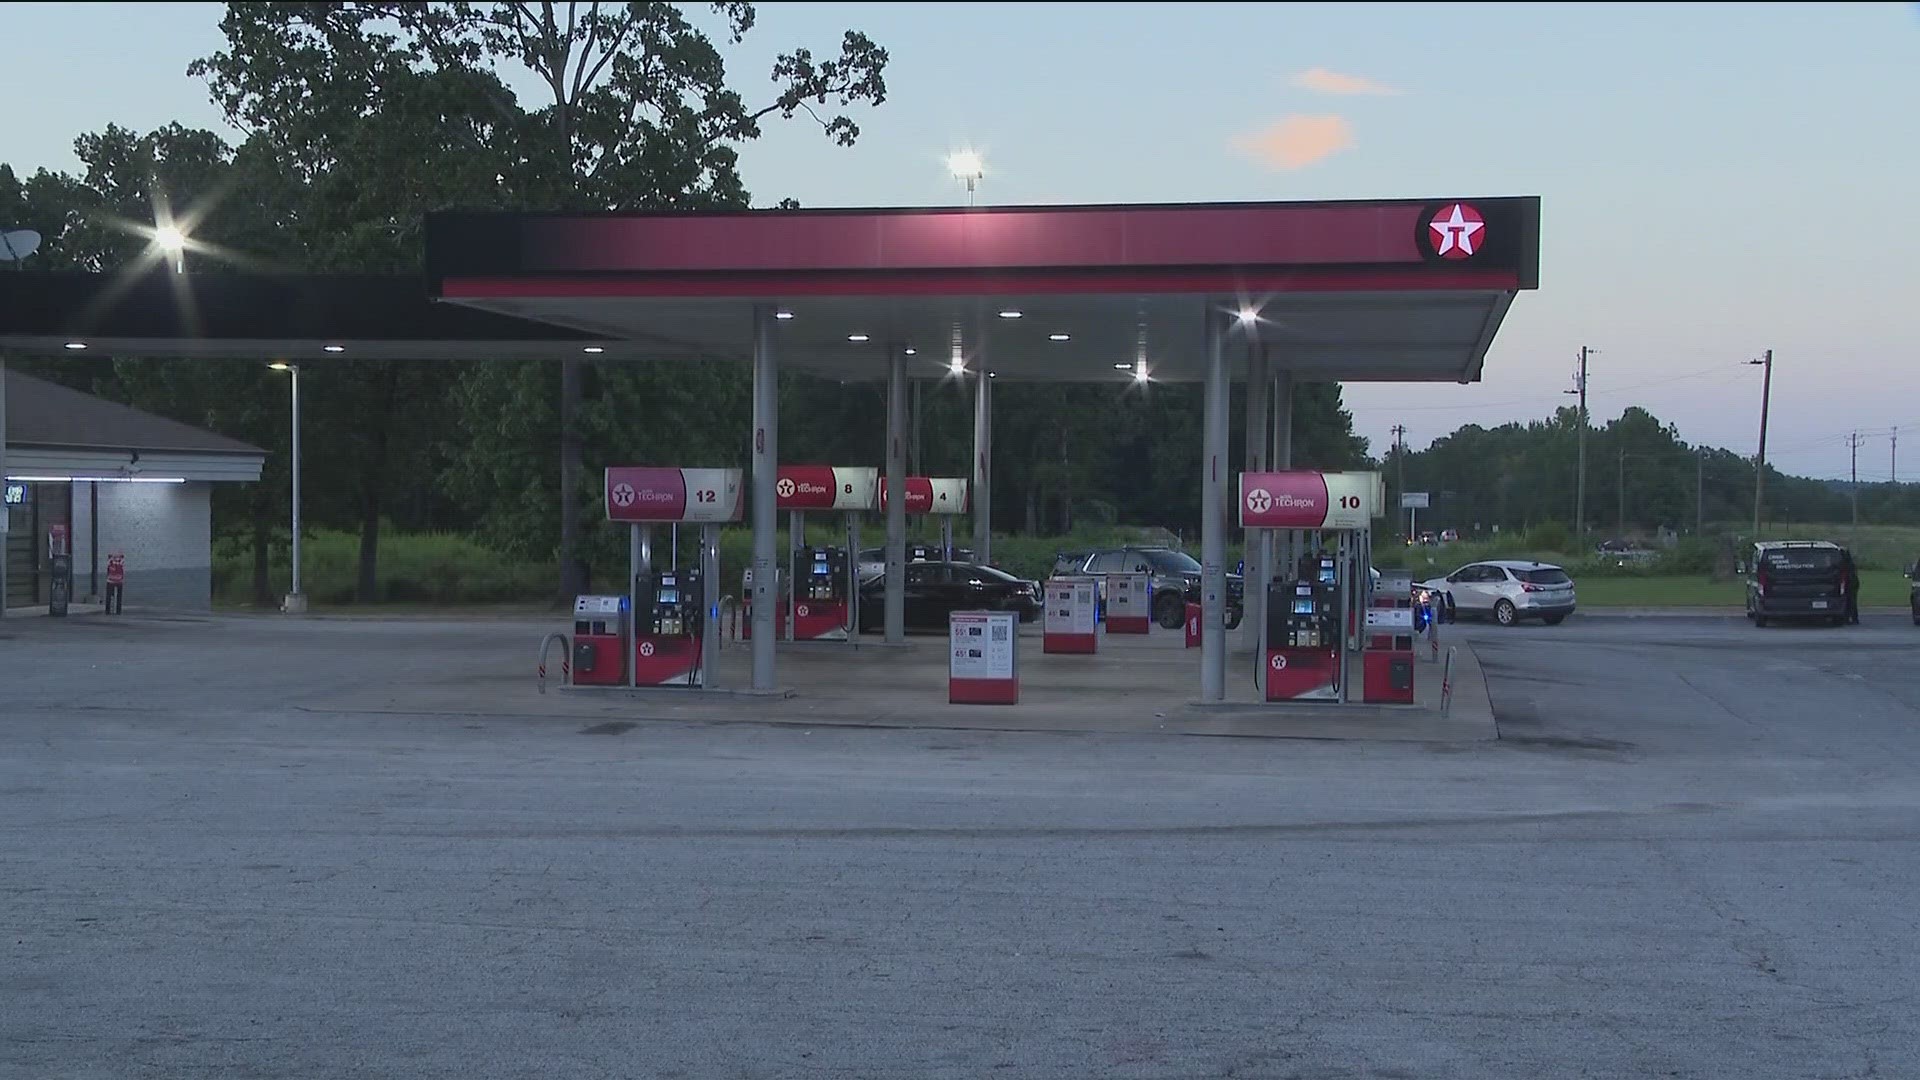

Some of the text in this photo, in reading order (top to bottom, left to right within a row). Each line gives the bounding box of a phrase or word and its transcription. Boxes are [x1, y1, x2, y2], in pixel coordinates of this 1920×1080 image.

[844, 483, 853, 494] 8
[638, 491, 674, 503] TECHRON
[696, 489, 717, 503] 12
[939, 492, 947, 501] 4
[1275, 498, 1315, 508] TECHRON
[1339, 495, 1360, 509] 10
